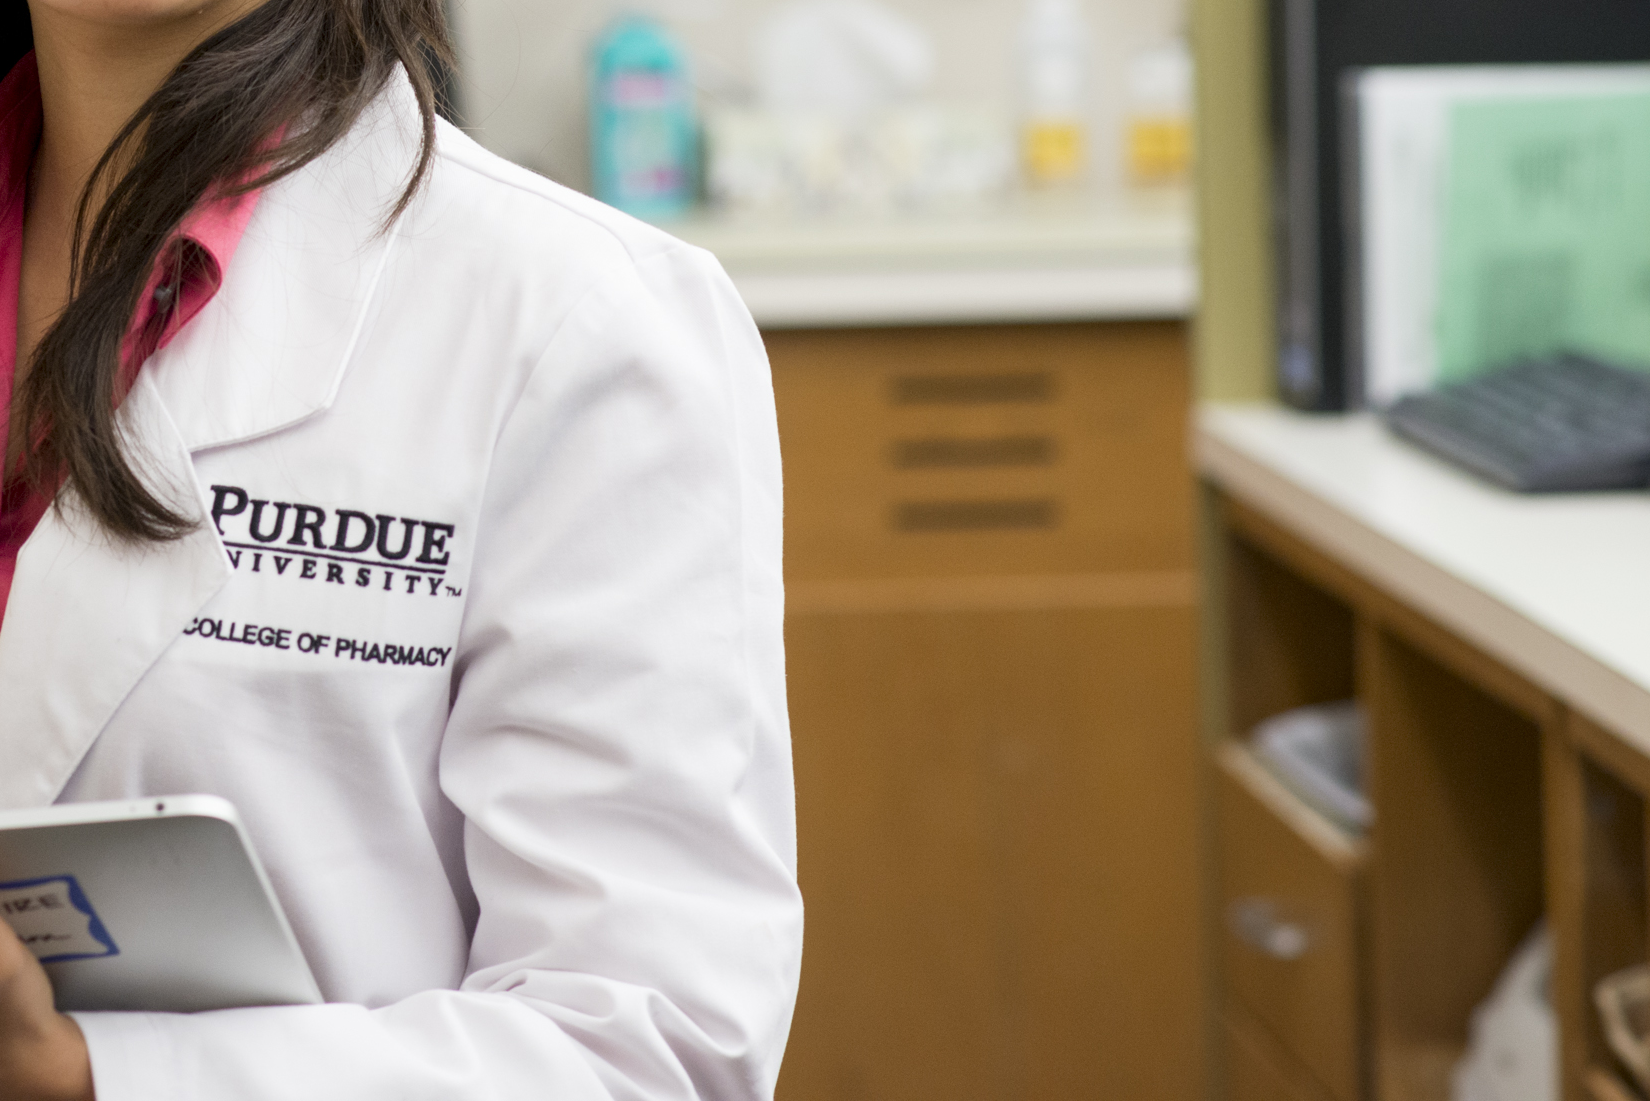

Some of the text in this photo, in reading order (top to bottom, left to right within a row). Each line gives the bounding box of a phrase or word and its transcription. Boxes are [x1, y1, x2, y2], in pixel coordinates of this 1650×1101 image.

[210, 484, 455, 566] PURDUE
[226, 549, 444, 596] NIVERSITY
[297, 632, 330, 654] OF
[335, 637, 452, 667] PHARMACY
